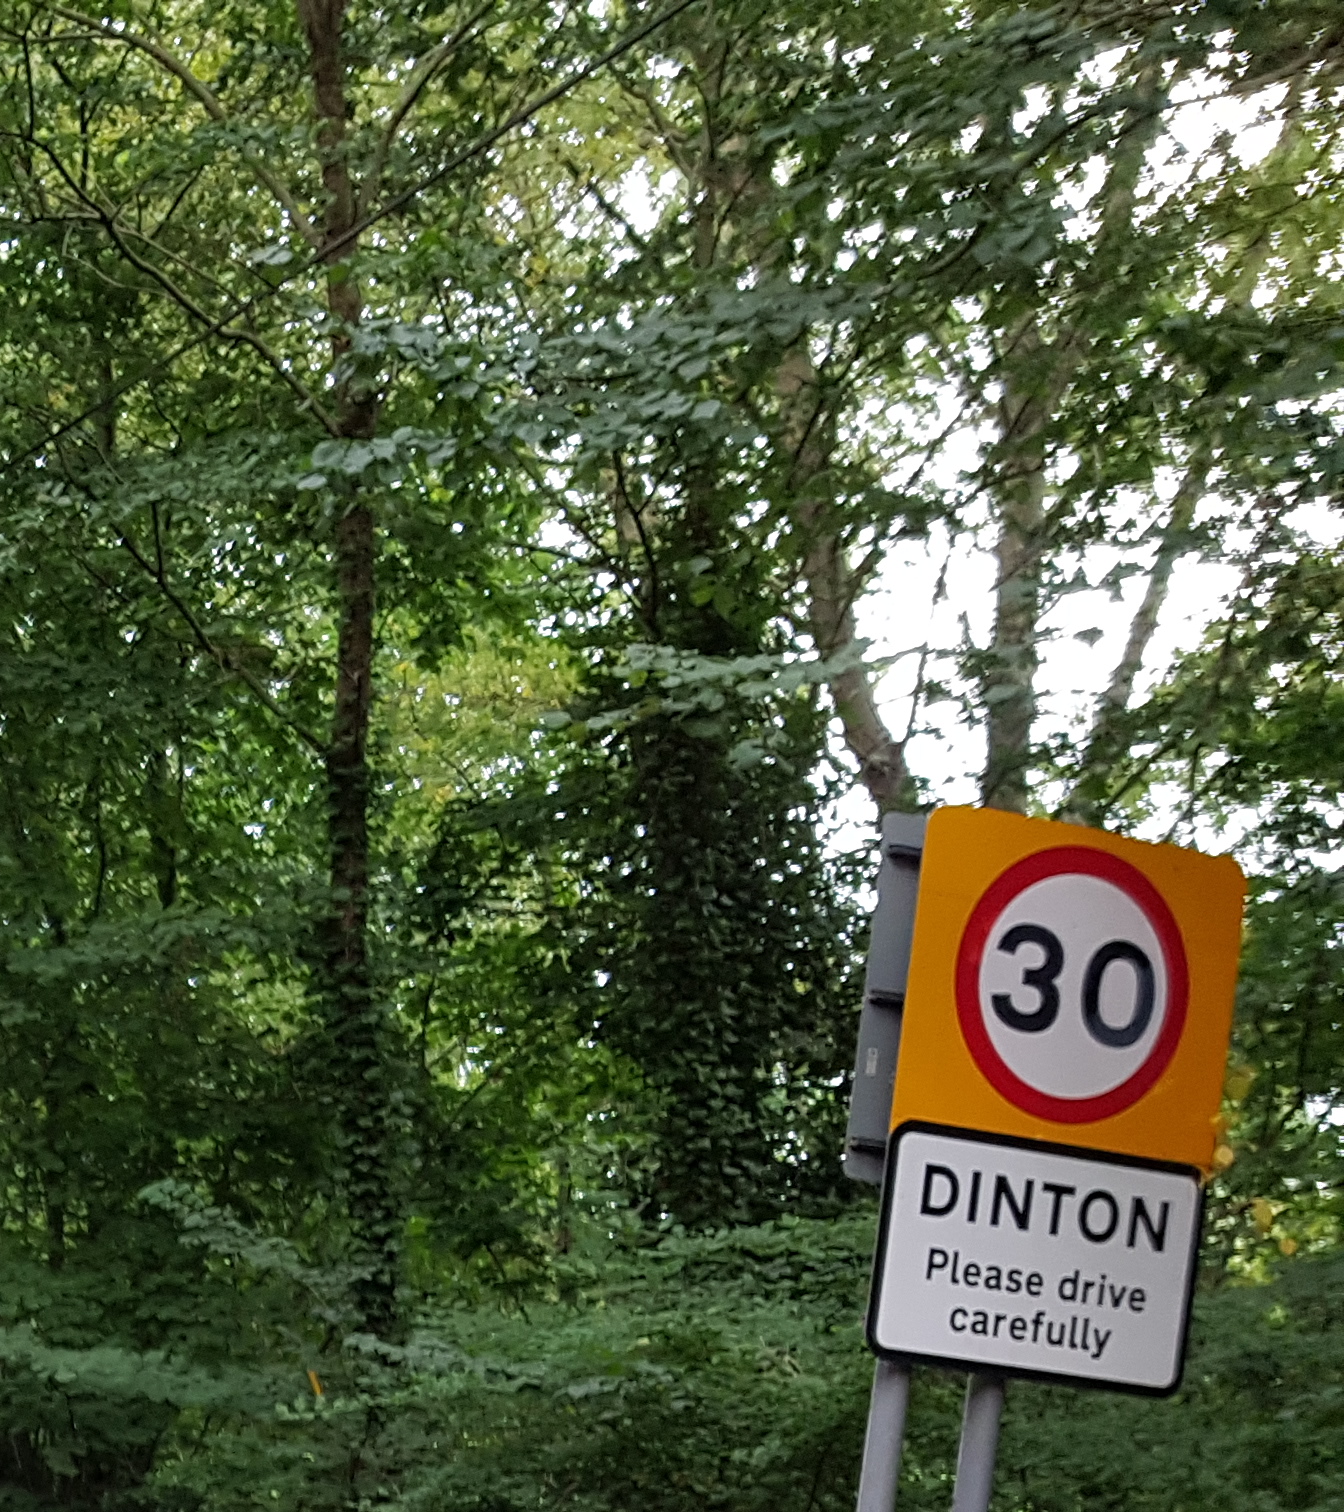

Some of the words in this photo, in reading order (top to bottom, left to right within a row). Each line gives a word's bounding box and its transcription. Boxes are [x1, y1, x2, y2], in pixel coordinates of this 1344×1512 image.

[990, 923, 1156, 1048] 30
[920, 1164, 1171, 1252] DINTON
[926, 1248, 1044, 1297] Please
[1057, 1271, 1147, 1311] drive
[949, 1306, 1112, 1359] carefully
